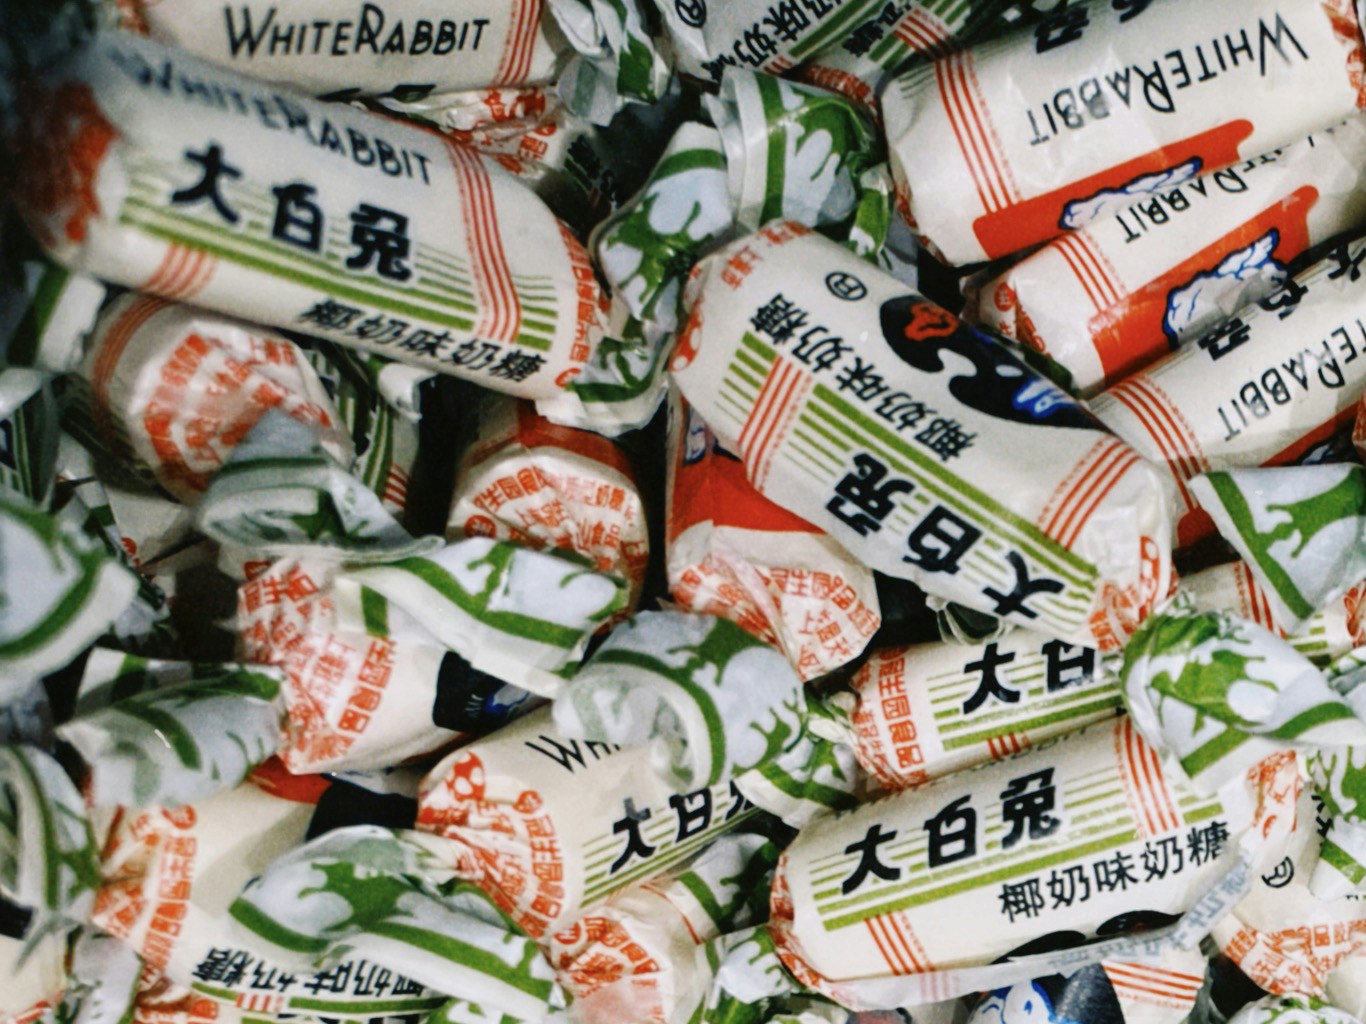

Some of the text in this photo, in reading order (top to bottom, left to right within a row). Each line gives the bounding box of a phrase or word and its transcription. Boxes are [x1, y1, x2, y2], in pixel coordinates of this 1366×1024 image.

[224, 3, 490, 59] WHITERABBIT
[1026, 12, 1310, 147] WHITERABBIT
[172, 145, 414, 283] 大白兔
[301, 300, 547, 383] 椰奶味奶糖
[751, 293, 977, 464] 椰奶味奶糖
[827, 452, 1065, 620] 大白兔
[842, 767, 1062, 895] 大白兔
[997, 819, 1230, 924] 椰奶味奶糖
